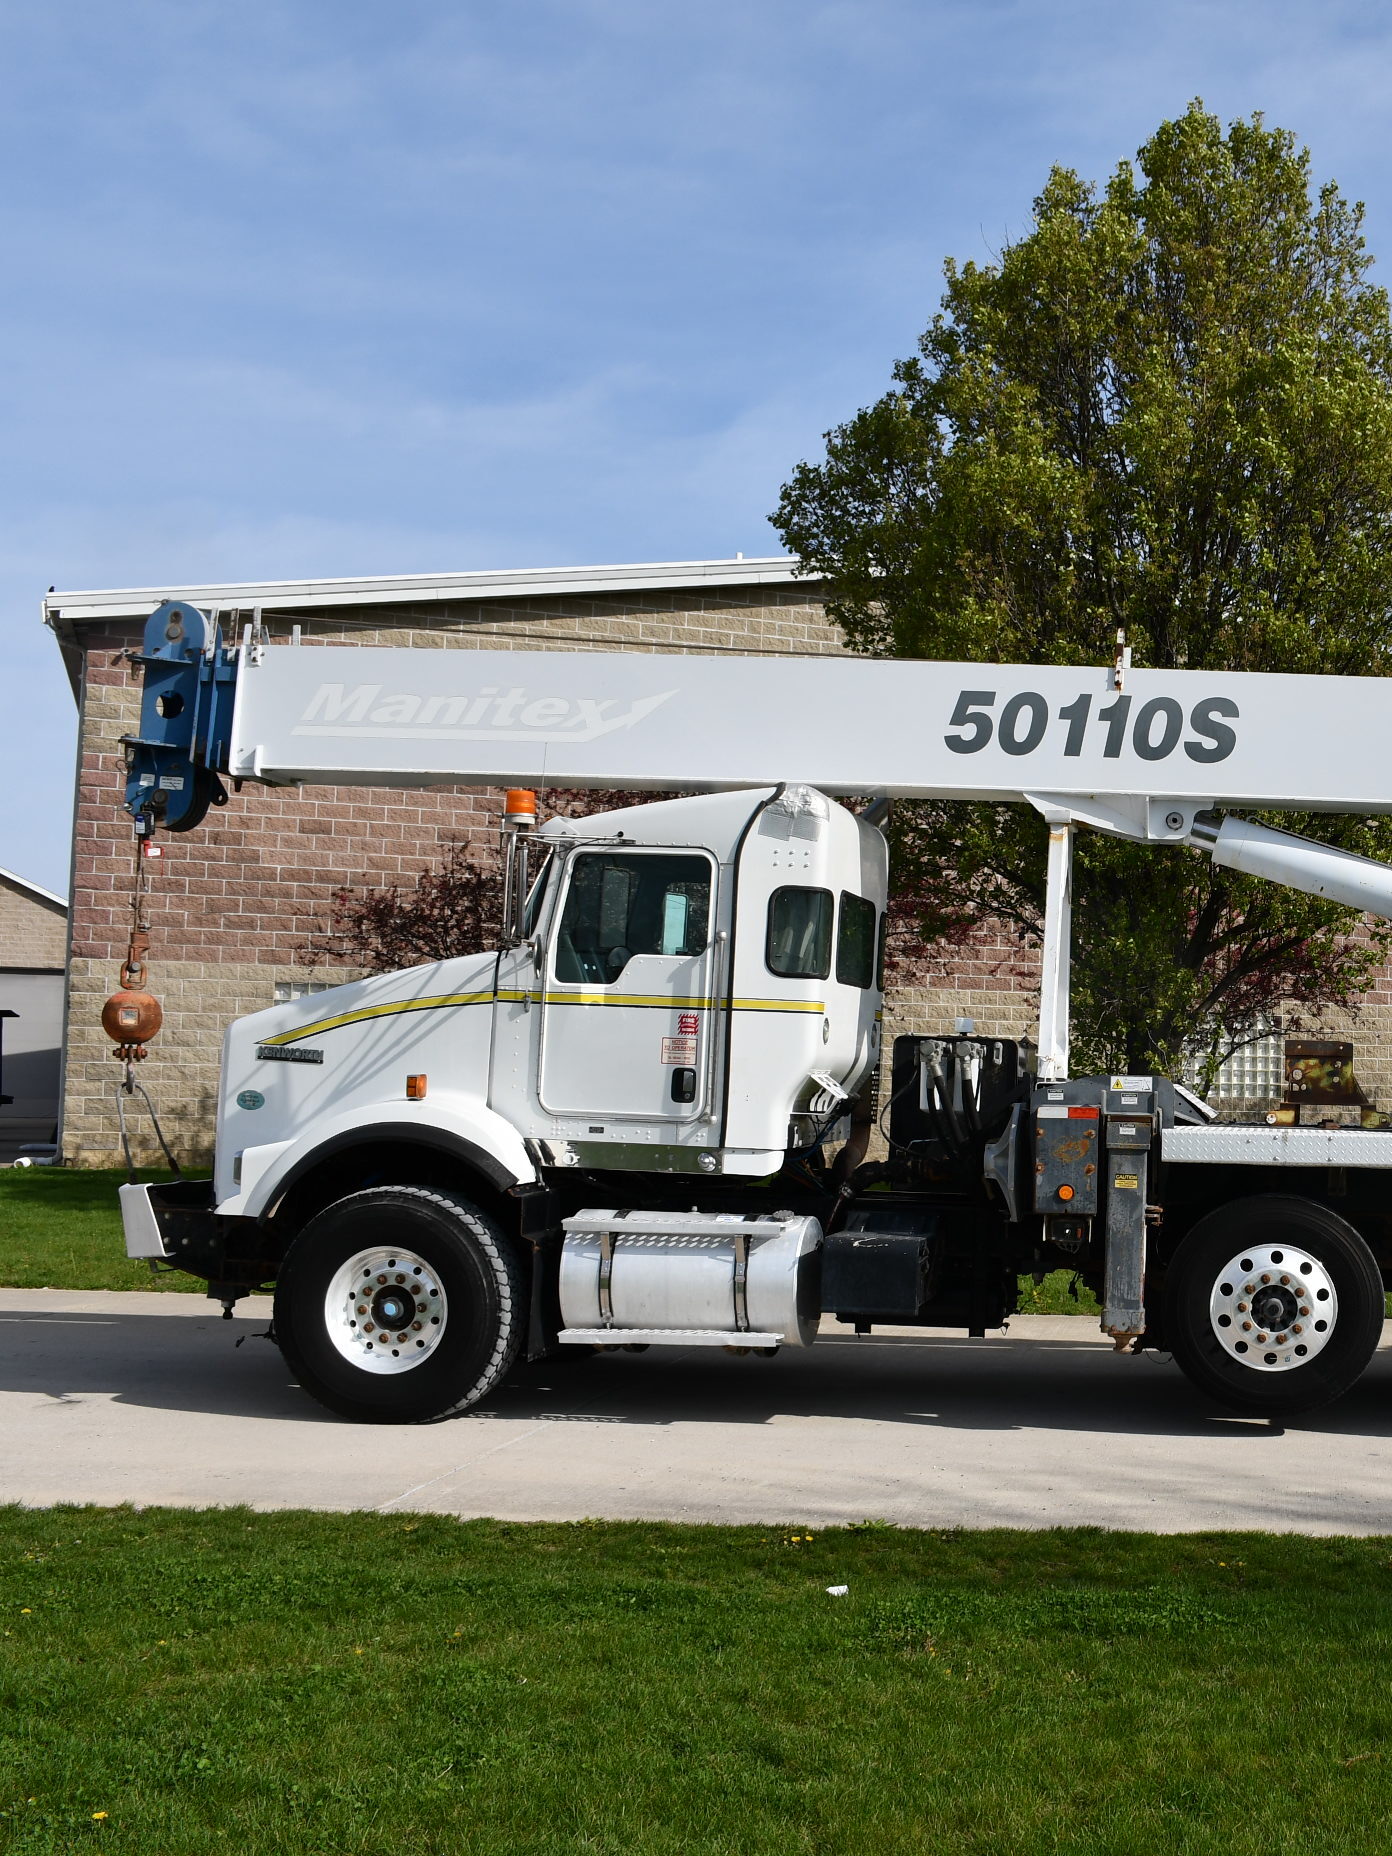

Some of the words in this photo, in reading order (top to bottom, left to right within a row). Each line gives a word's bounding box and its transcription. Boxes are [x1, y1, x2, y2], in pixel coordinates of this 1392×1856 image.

[300, 683, 620, 730] Manitex
[943, 689, 1240, 764] 50110S
[256, 1046, 324, 1062] KENWORTH
